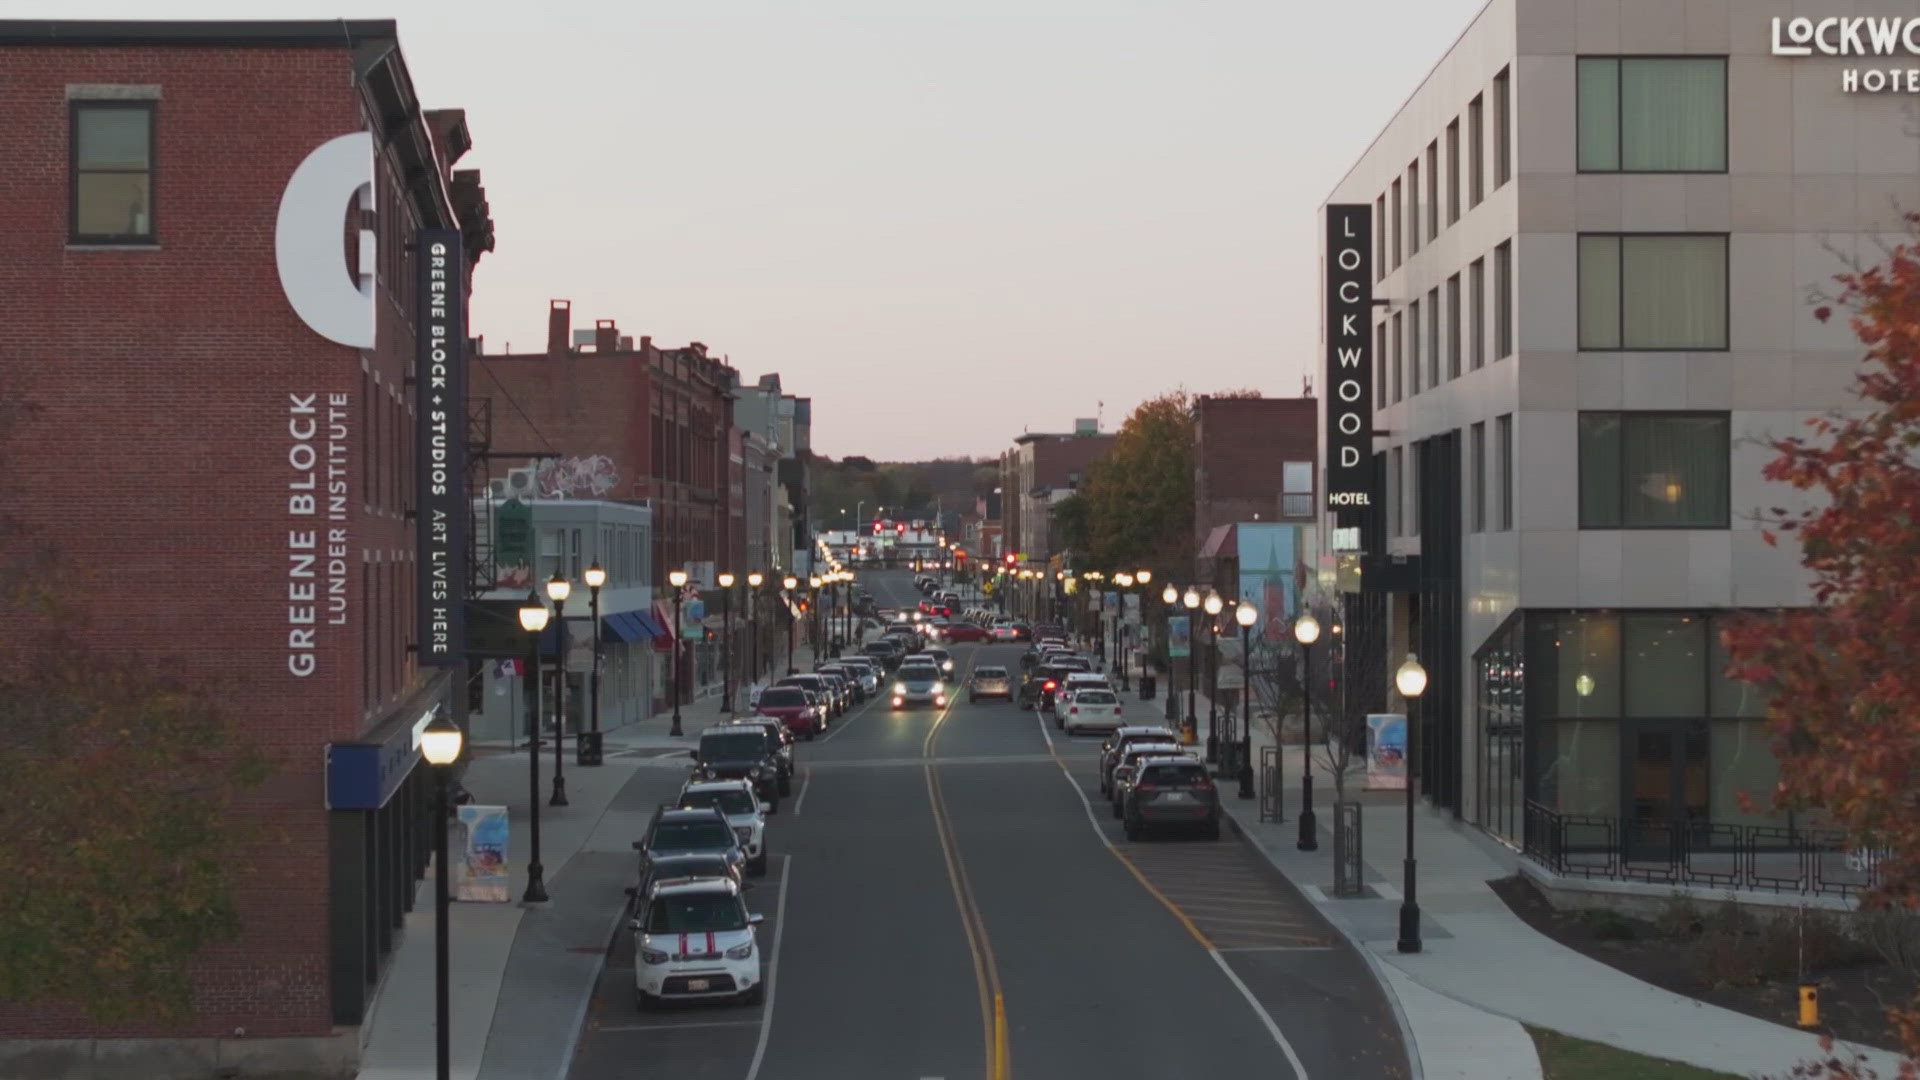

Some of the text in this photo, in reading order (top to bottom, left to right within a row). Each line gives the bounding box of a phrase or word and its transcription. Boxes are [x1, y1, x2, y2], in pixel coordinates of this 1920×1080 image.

[1843, 69, 1920, 92] HOTE
[431, 243, 446, 318] GREENE
[431, 325, 446, 388] BLOCK
[1338, 216, 1361, 467] LOCKWOOD
[431, 410, 446, 495] STUDIOS
[328, 393, 347, 625] LUNDER INSTITUTE
[433, 509, 447, 543] ART
[1329, 493, 1370, 505] HOTEL
[289, 392, 316, 677] GREENE BLOCK
[432, 551, 447, 601] LIVES
[433, 609, 447, 653] HERE
